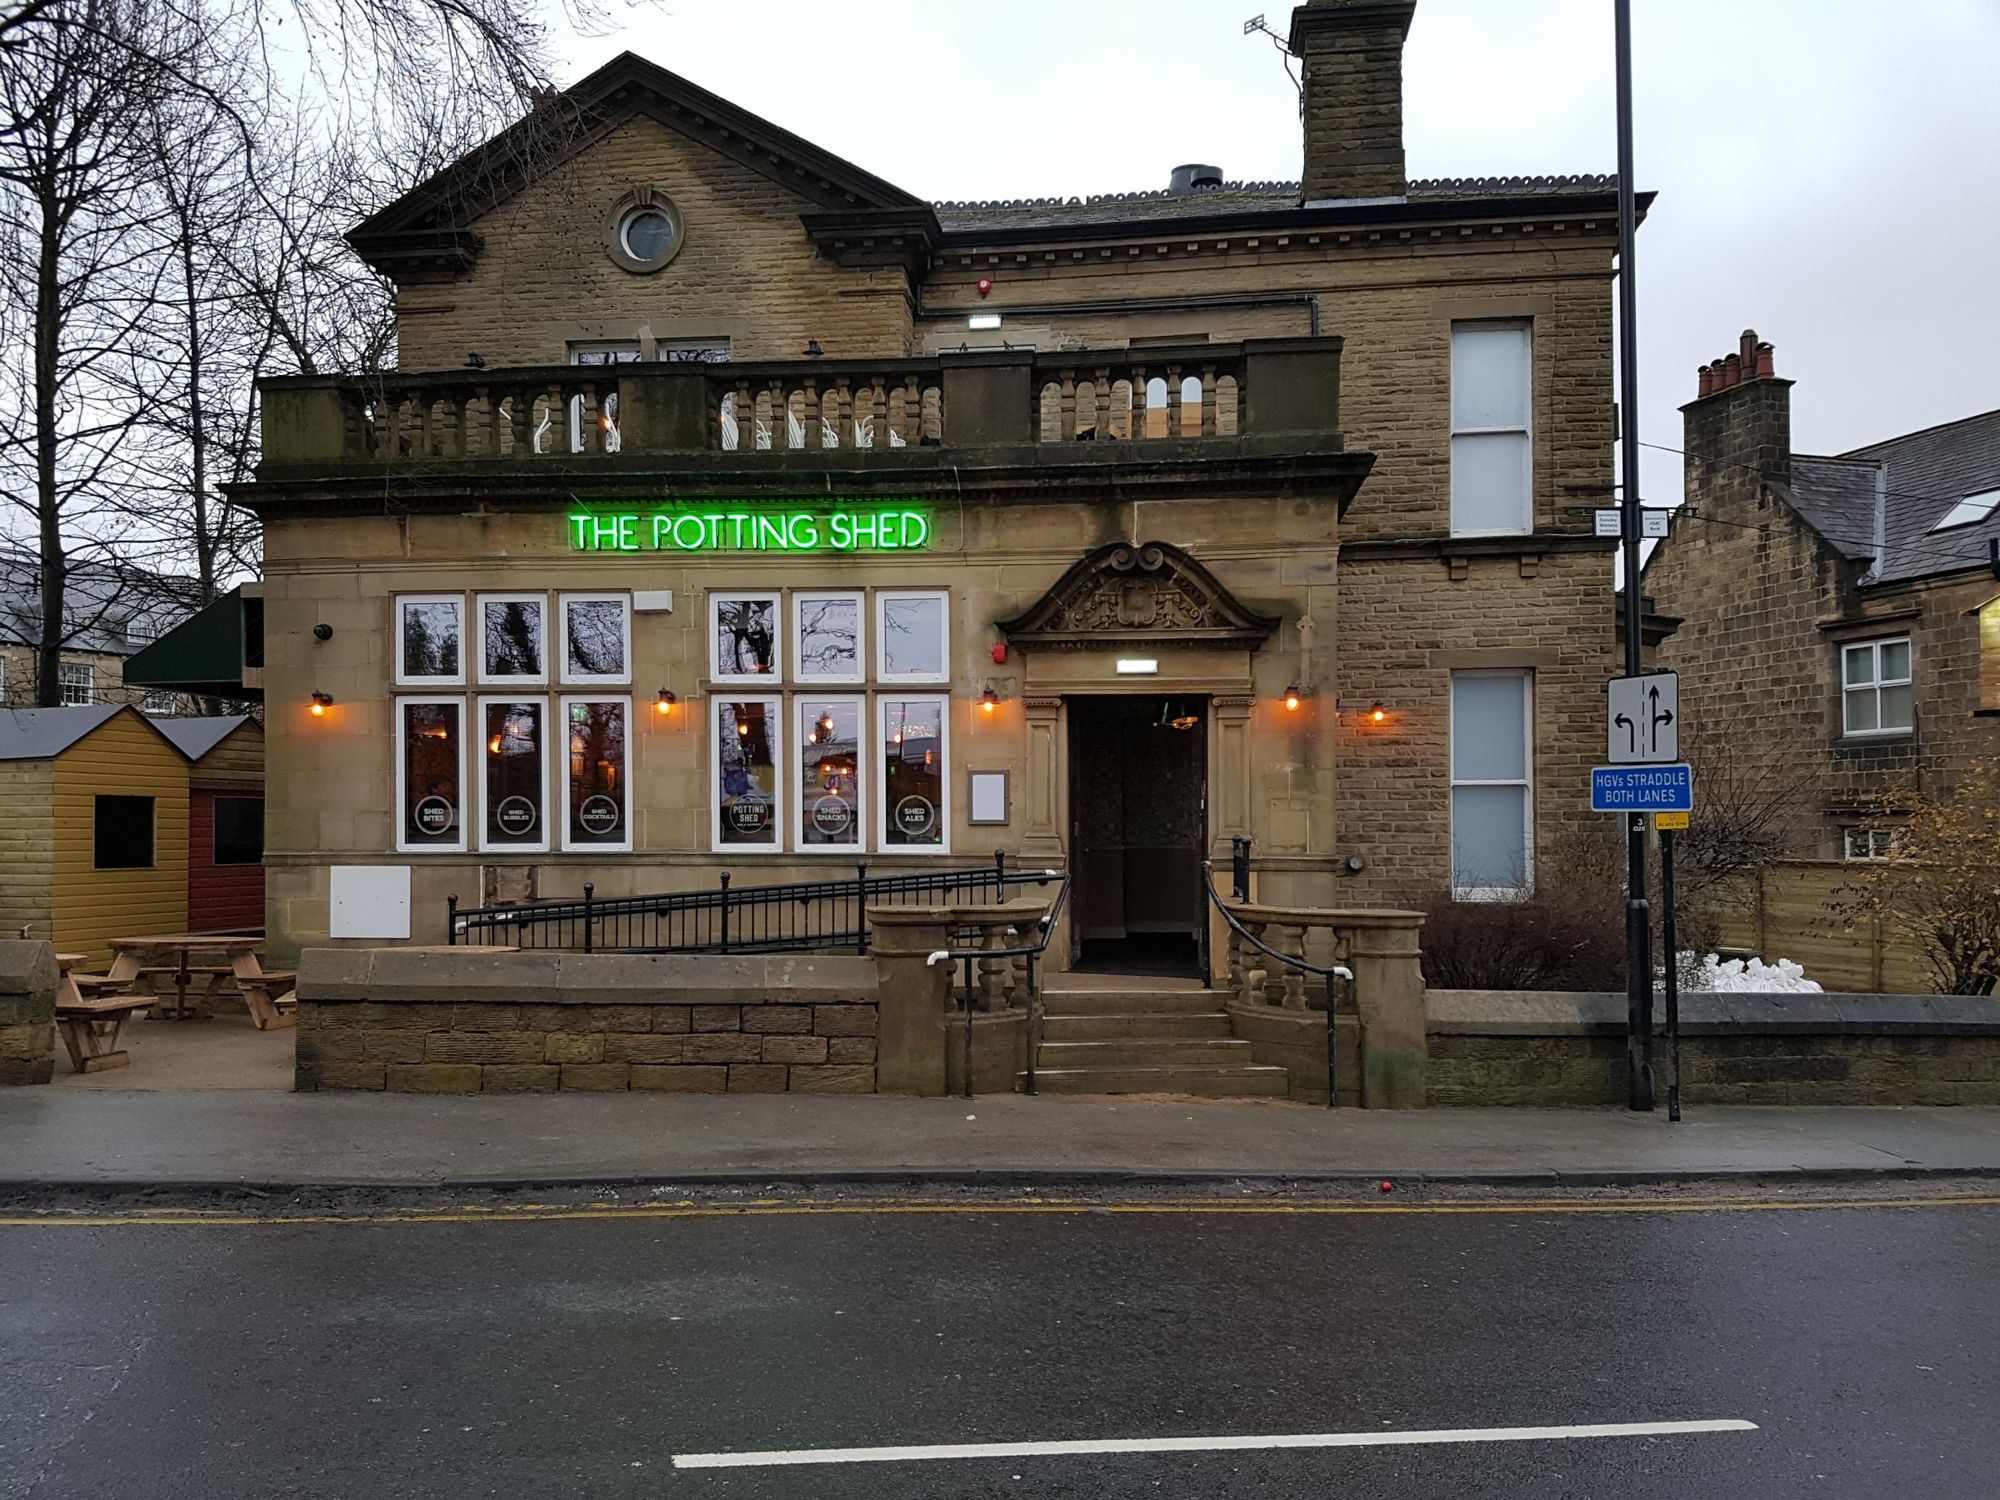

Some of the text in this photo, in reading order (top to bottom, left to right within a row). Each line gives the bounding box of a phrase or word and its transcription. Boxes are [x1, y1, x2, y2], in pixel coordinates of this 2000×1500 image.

[570, 512, 926, 550] THE POTTING SHED
[1596, 772, 1686, 787] HGVs STRADDLE
[1605, 788, 1676, 803] BOTH LANES
[423, 807, 444, 815] SHED
[733, 805, 765, 814] POTTING
[904, 807, 925, 815] SHED
[423, 814, 444, 822] BITES
[739, 813, 759, 822] SHED
[904, 814, 925, 822] ALES
[1637, 818, 1643, 826] 3
